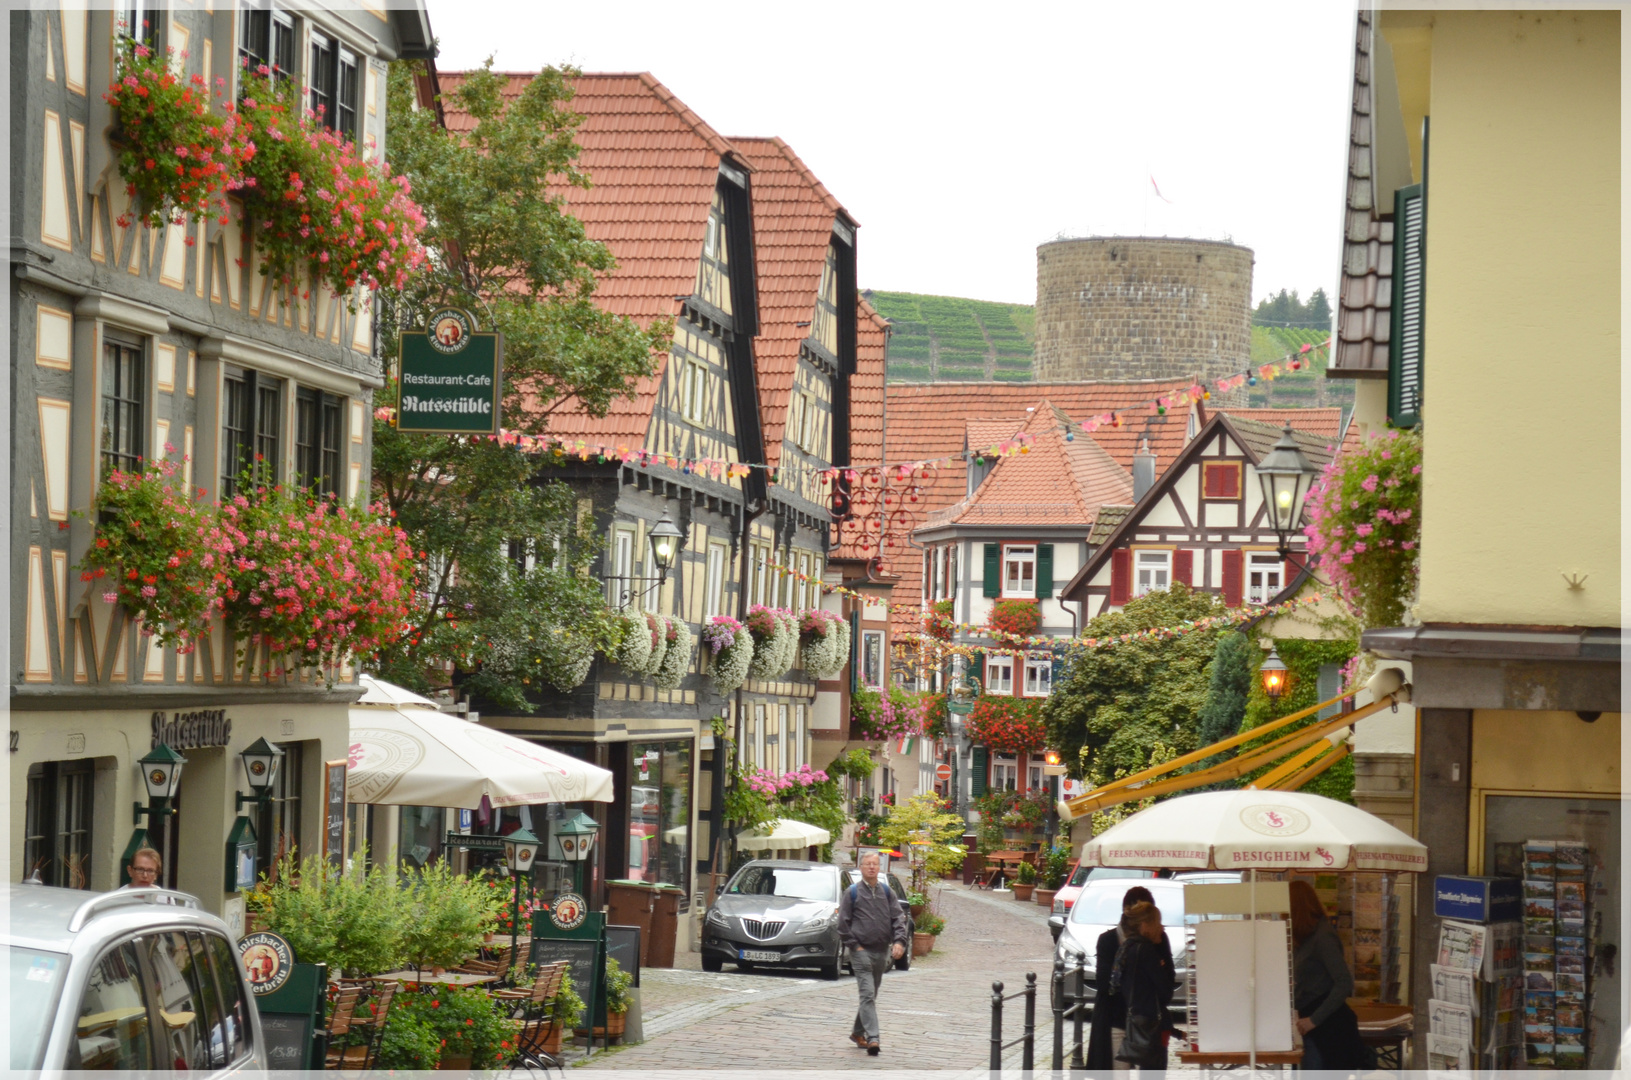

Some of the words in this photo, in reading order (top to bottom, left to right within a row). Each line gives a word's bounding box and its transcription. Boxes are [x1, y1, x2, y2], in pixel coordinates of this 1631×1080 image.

[429, 310, 468, 331] Alpirsbacher
[429, 335, 469, 353] Klosterbräu
[403, 373, 491, 386] Restaurant-Cafe
[402, 395, 492, 414] Ratsstüble
[1233, 851, 1311, 863] BESIGHEIM
[239, 934, 288, 964] pirsbacher
